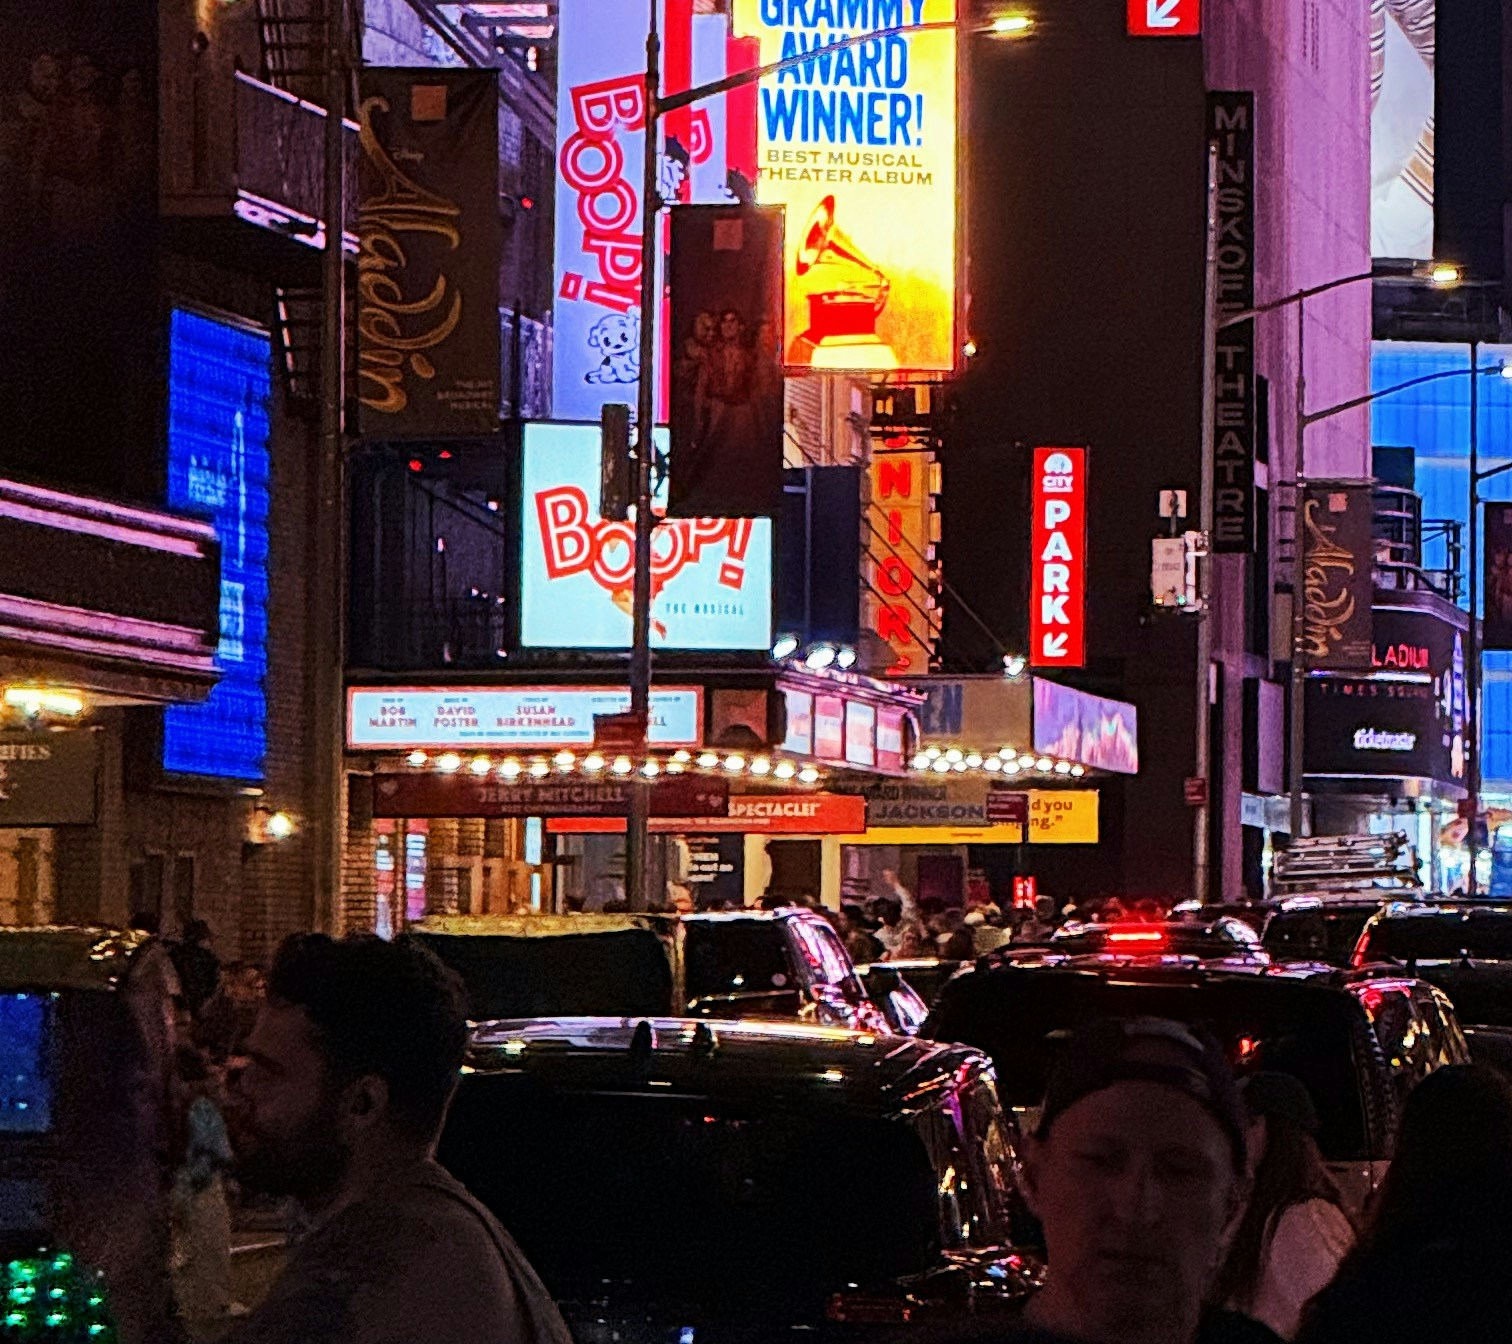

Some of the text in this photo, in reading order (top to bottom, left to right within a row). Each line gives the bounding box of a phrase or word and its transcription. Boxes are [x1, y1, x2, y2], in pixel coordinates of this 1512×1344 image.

[777, 32, 909, 89] AWARD
[760, 88, 924, 146] WINNER!
[767, 149, 923, 168] BEST MUSICAL
[758, 166, 933, 186] THEATER ALBUM
[1214, 344, 1247, 543] THEATRE
[533, 485, 755, 591] BOOP!
[1041, 499, 1073, 625] PARK
[1370, 643, 1430, 669] LADIUM
[380, 706, 406, 716] BOB
[437, 706, 476, 716] DAVID
[515, 705, 556, 715] SUSAN
[368, 717, 417, 728] MARTIN
[433, 717, 479, 728] FOSTER
[875, 805, 984, 819] JACKSON
